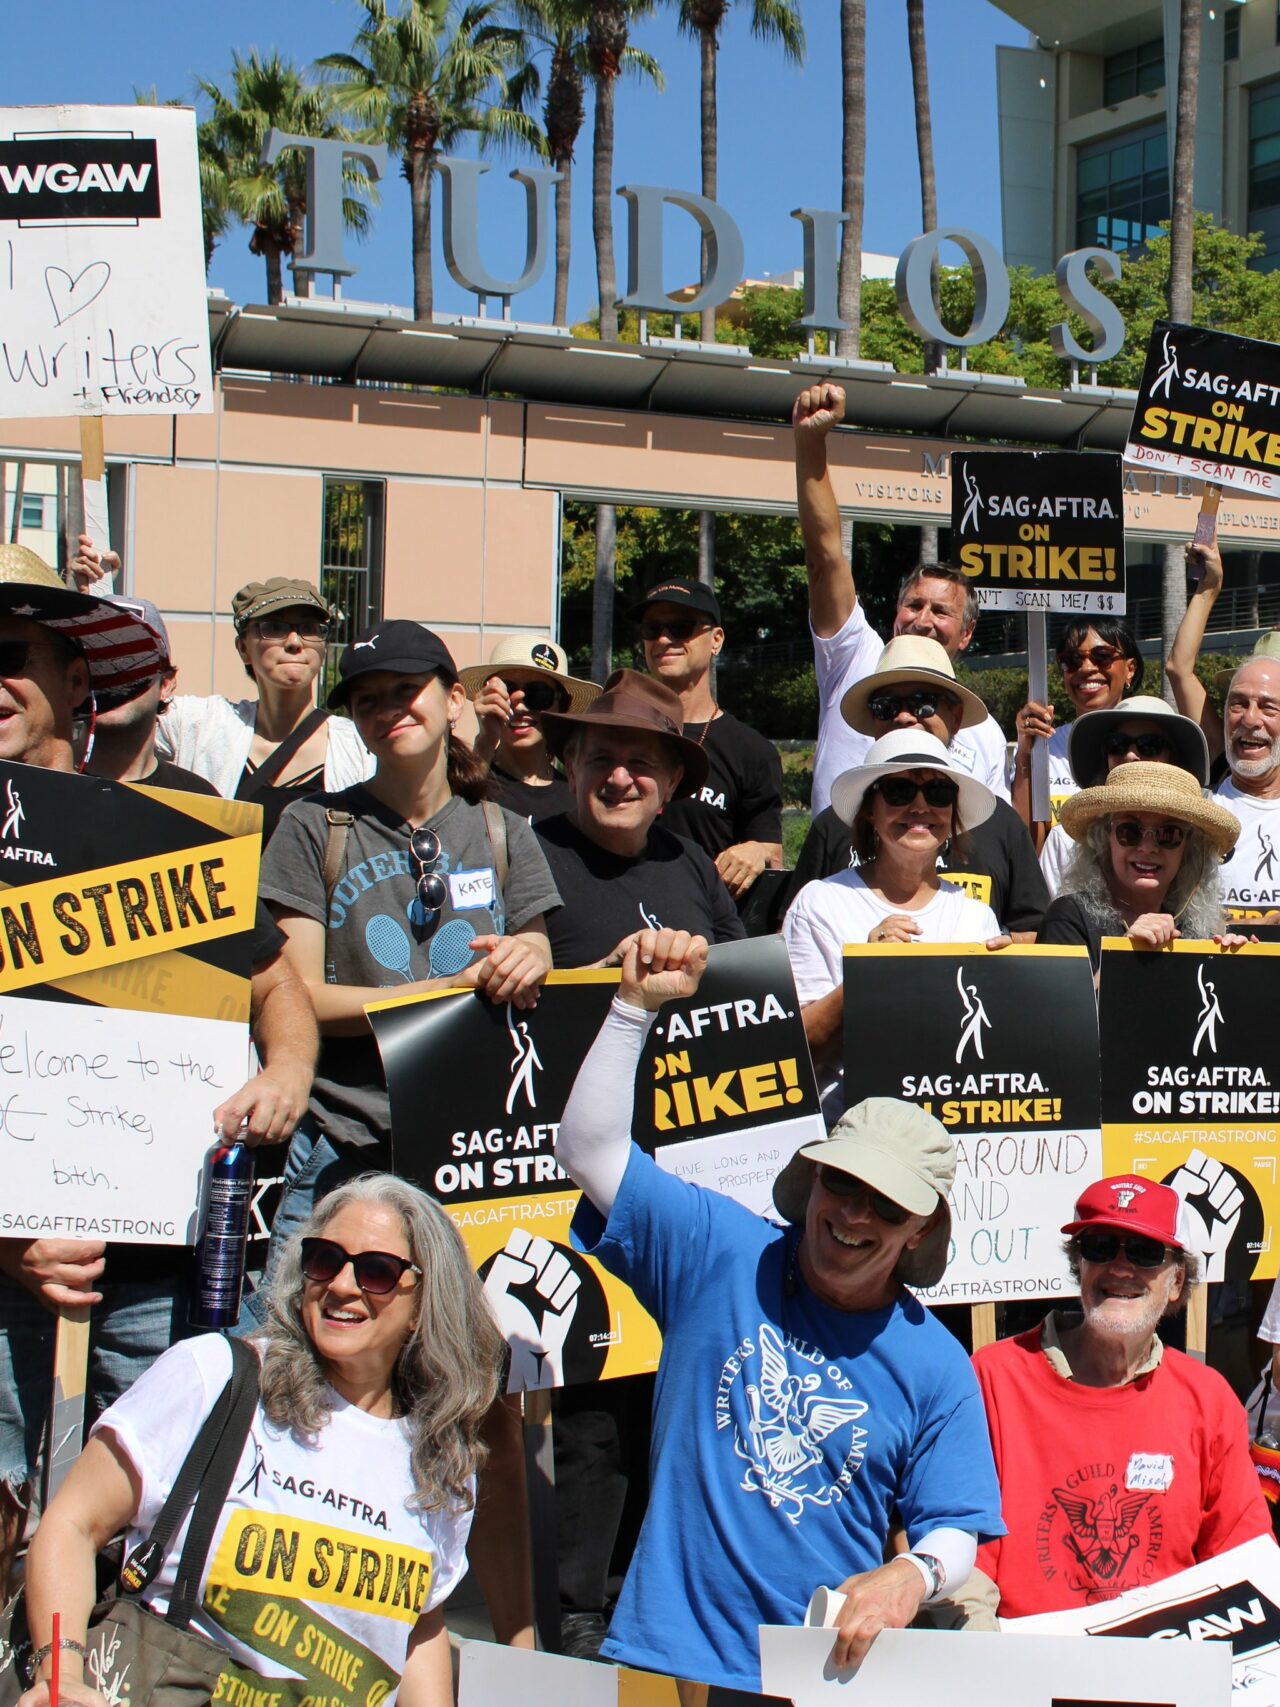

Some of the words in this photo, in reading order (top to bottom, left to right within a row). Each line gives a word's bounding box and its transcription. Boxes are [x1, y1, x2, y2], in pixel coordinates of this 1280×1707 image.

[0, 163, 152, 193] WGAW
[2, 329, 200, 388] Writers
[100, 386, 188, 407] Friends
[1211, 400, 1245, 422] ON
[1190, 459, 1236, 480] SCAN
[1242, 470, 1273, 488] ME
[855, 482, 944, 504] VISITORS
[1018, 524, 1050, 542] ON
[959, 543, 1117, 582] STRIKE!
[1015, 592, 1051, 608] SCAN
[459, 875, 494, 897] KATE
[52, 857, 237, 957] STRIKE
[0, 1028, 118, 1080] elcome
[127, 1040, 160, 1081] to
[168, 1051, 224, 1089] the
[655, 1057, 804, 1131] RIKE!
[1131, 1091, 1172, 1115] ON
[1178, 1091, 1280, 1114] STRIKE!
[941, 1098, 1063, 1126] STRIKE!
[1133, 1129, 1278, 1145] #SAGAFTRASTRONG
[674, 1162, 704, 1176] LIVE
[713, 1153, 748, 1171] LONG
[756, 1149, 780, 1162] AND
[956, 1134, 1088, 1180] AROUND
[52, 1159, 119, 1190] bitch.
[434, 1161, 484, 1193] ON
[492, 1154, 567, 1187] STRI
[0, 1214, 176, 1236] SAGAFTRASTRONG
[782, 1331, 826, 1366] UILD
[716, 1337, 756, 1431] WRITERS
[827, 1365, 853, 1391] OF
[1065, 1463, 1116, 1489] GUILD
[1132, 1457, 1165, 1471] David
[1036, 1500, 1058, 1583] WRITERS
[234, 1523, 300, 1582] ON
[308, 1536, 430, 1612] STRIKE
[253, 1602, 300, 1646] ON
[297, 1628, 366, 1693] STRIKE
